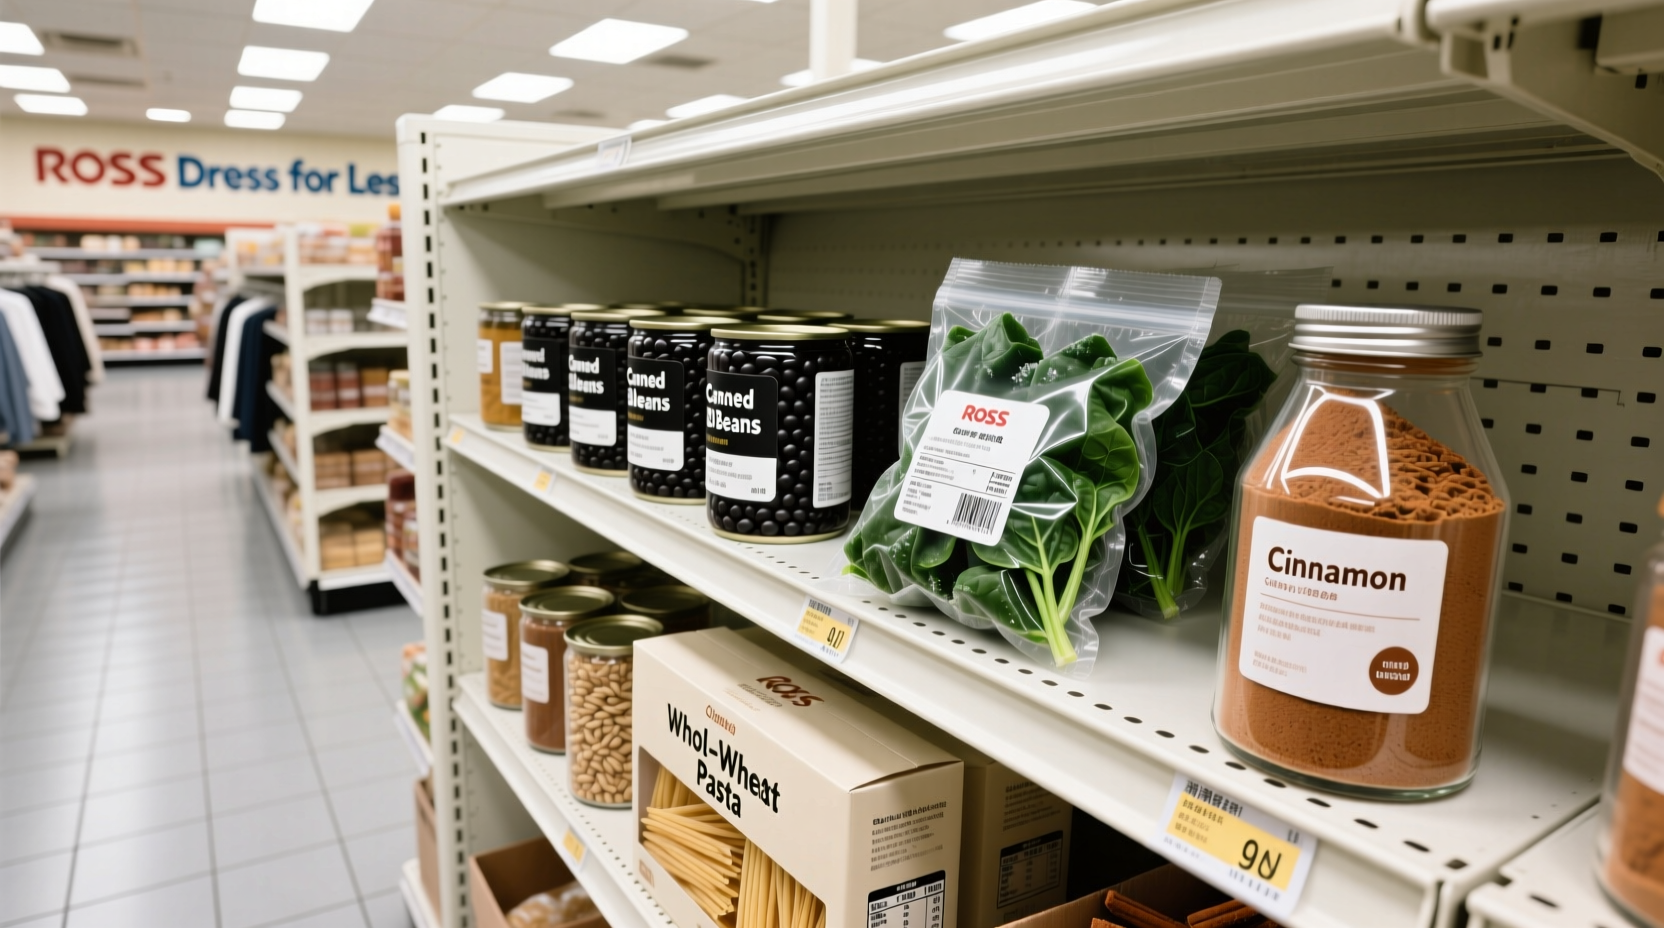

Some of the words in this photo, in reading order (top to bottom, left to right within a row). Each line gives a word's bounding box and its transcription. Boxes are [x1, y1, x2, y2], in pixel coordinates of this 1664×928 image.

[35, 148, 166, 187] ROSS
[177, 156, 279, 190] Dress
[289, 159, 338, 192] for
[961, 404, 1010, 427] ROSS
[1267, 546, 1407, 591] Cinnamon
[696, 758, 742, 818] Pasta
